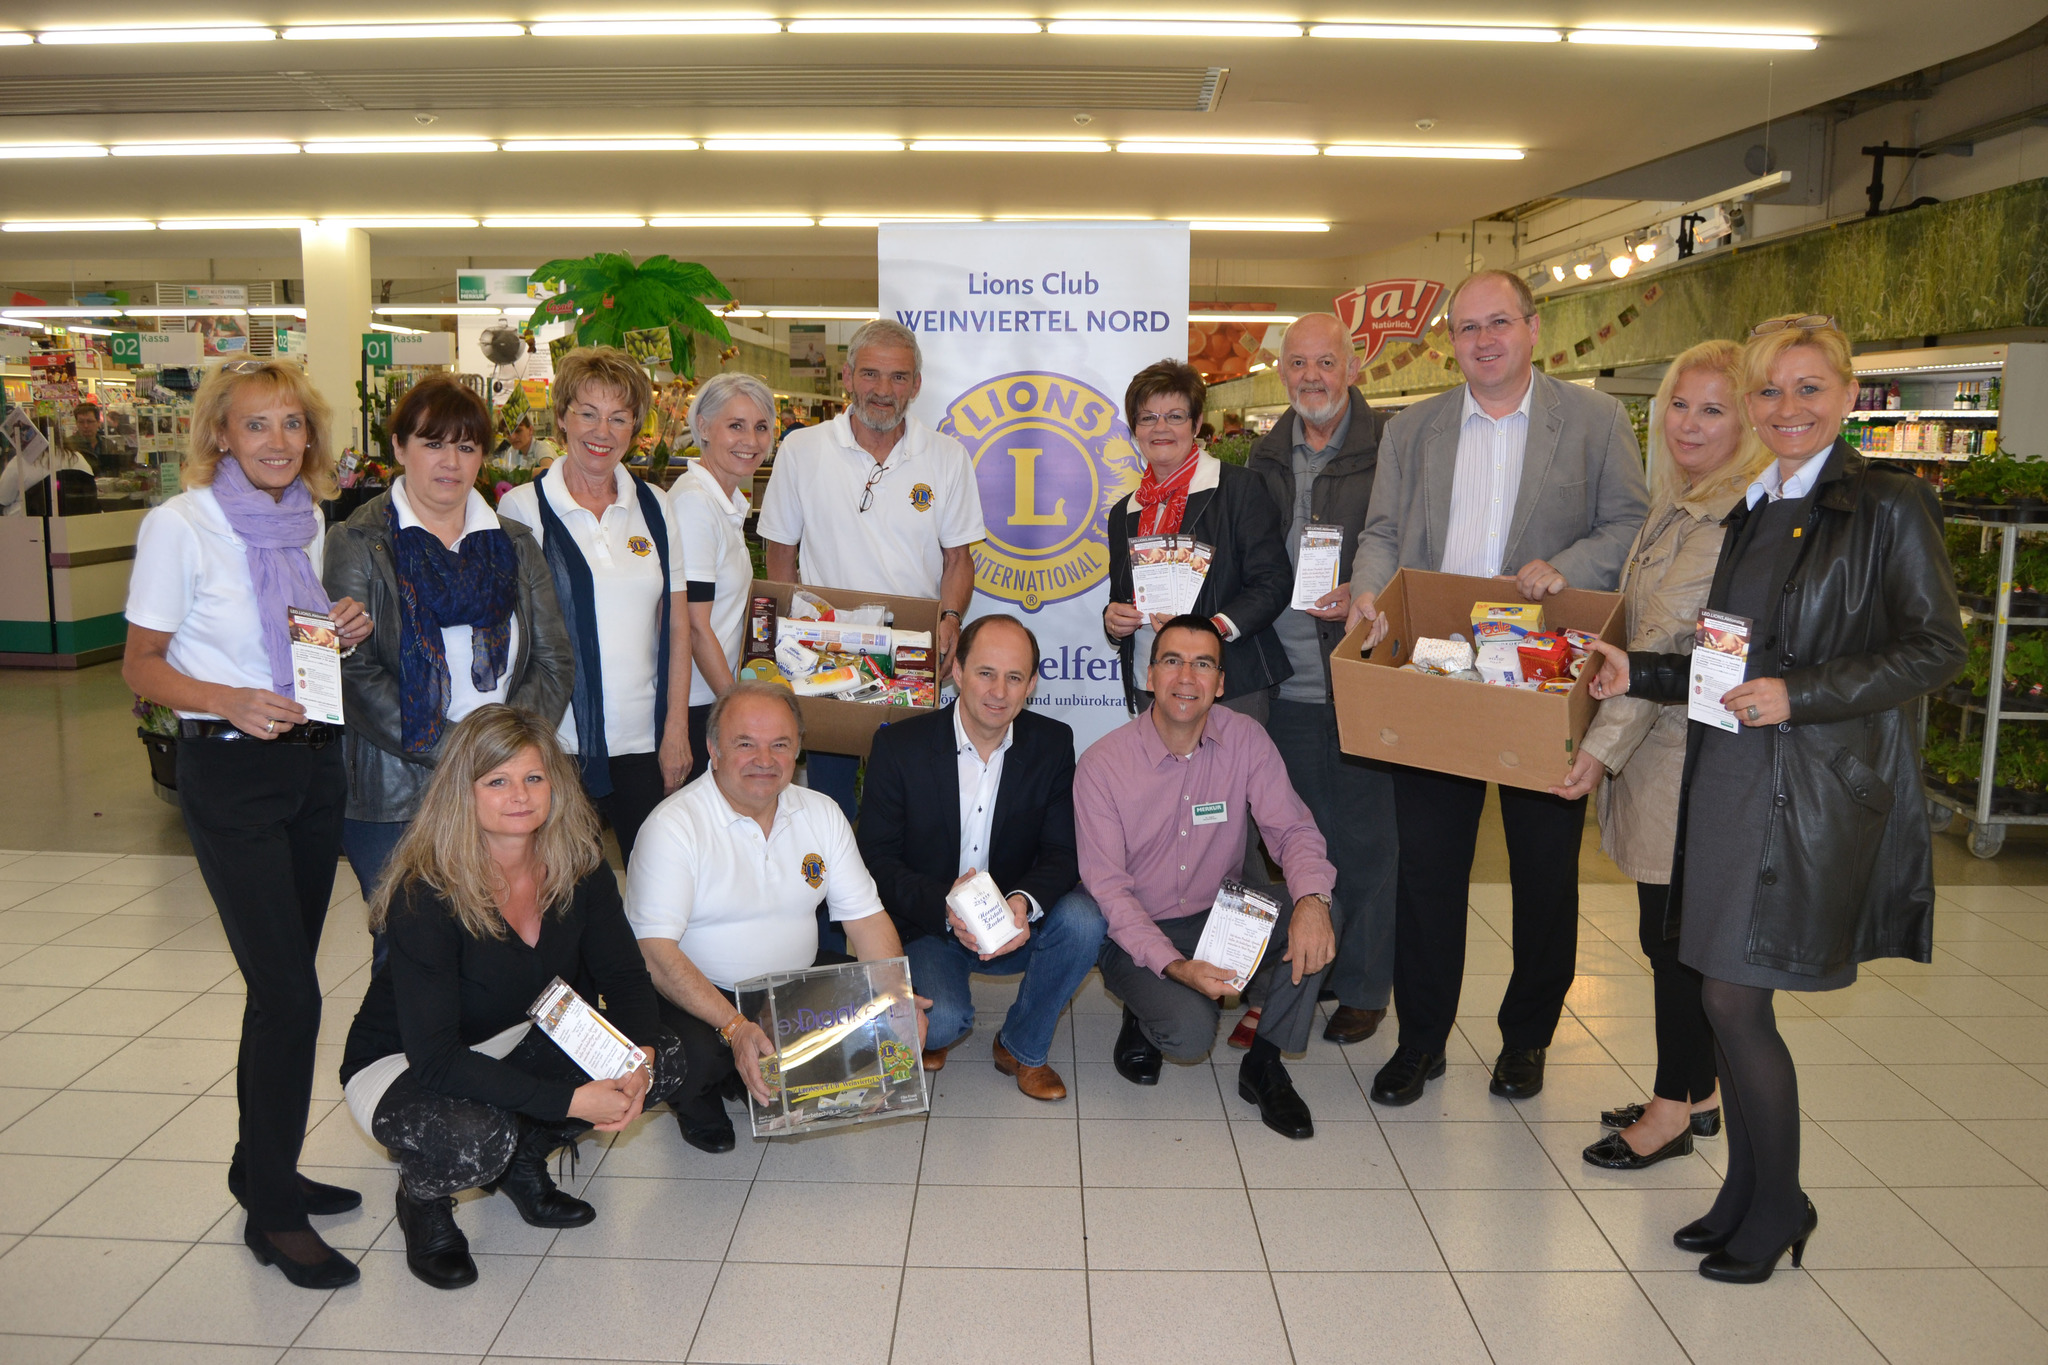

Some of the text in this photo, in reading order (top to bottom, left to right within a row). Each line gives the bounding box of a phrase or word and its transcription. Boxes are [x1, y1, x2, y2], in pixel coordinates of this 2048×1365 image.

[968, 271, 1099, 295] Lions Club
[896, 310, 1170, 333] WEINVIERTEL NORD
[113, 338, 139, 356] 02
[141, 334, 170, 343] Kassa
[278, 335, 288, 348] 02
[393, 335, 422, 343] Kassa
[367, 341, 387, 359] 01
[961, 381, 1105, 432] LIONS
[1007, 448, 1067, 525] L
[971, 549, 1102, 592] INTERNATIONAL
[1026, 693, 1051, 706] und
[1196, 805, 1222, 813] MERKUR
